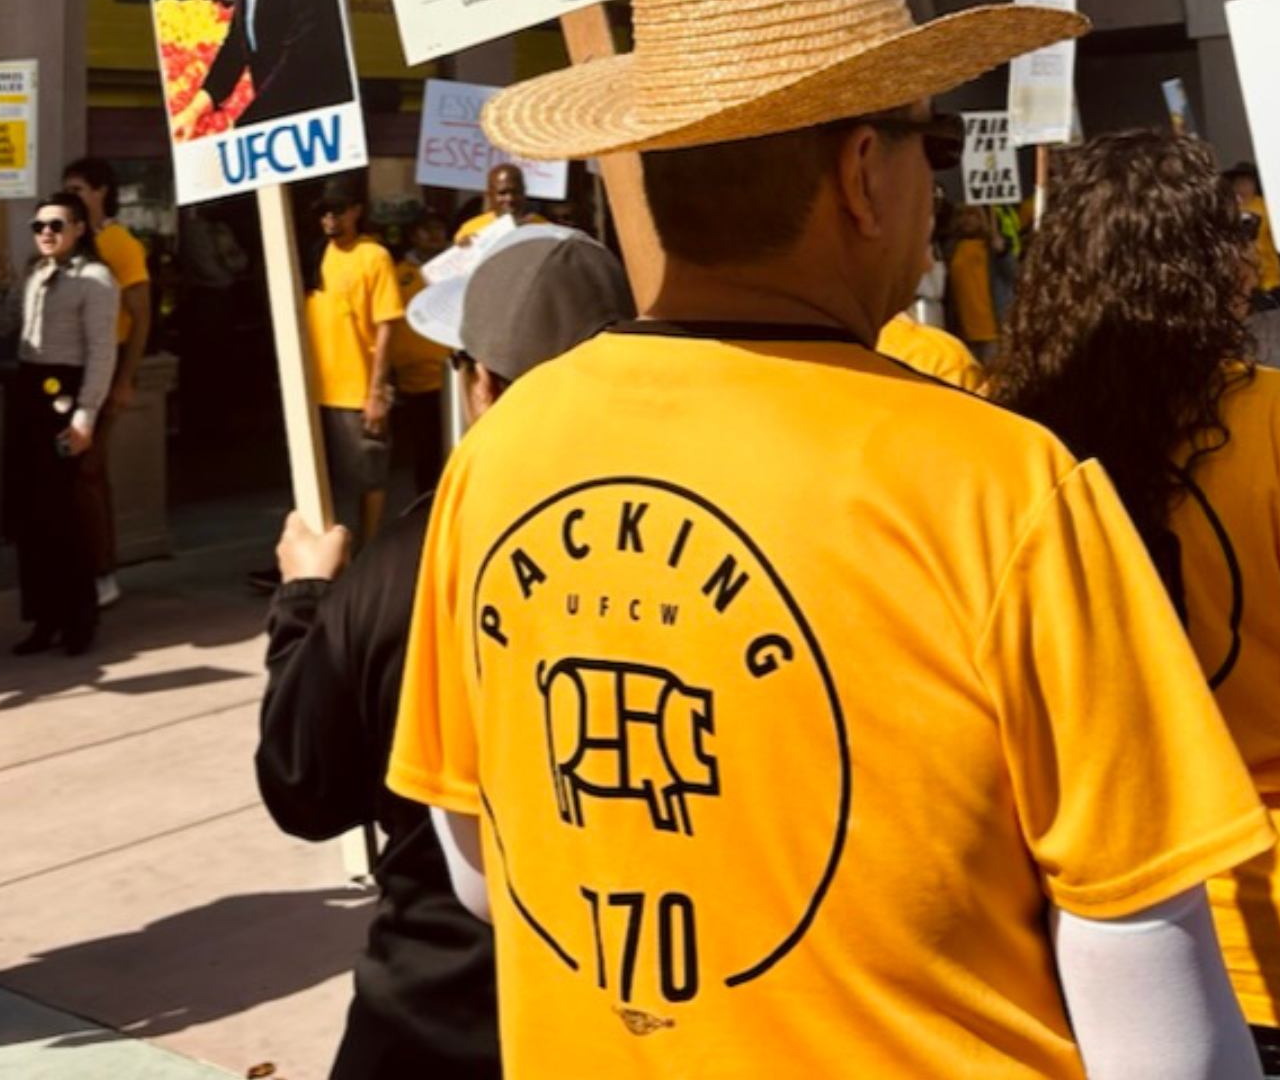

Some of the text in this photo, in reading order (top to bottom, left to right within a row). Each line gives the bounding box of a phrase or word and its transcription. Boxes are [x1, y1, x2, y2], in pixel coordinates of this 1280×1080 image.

[218, 114, 341, 186] UFCW
[480, 500, 795, 679] PACKING
[565, 593, 679, 626] UFCW
